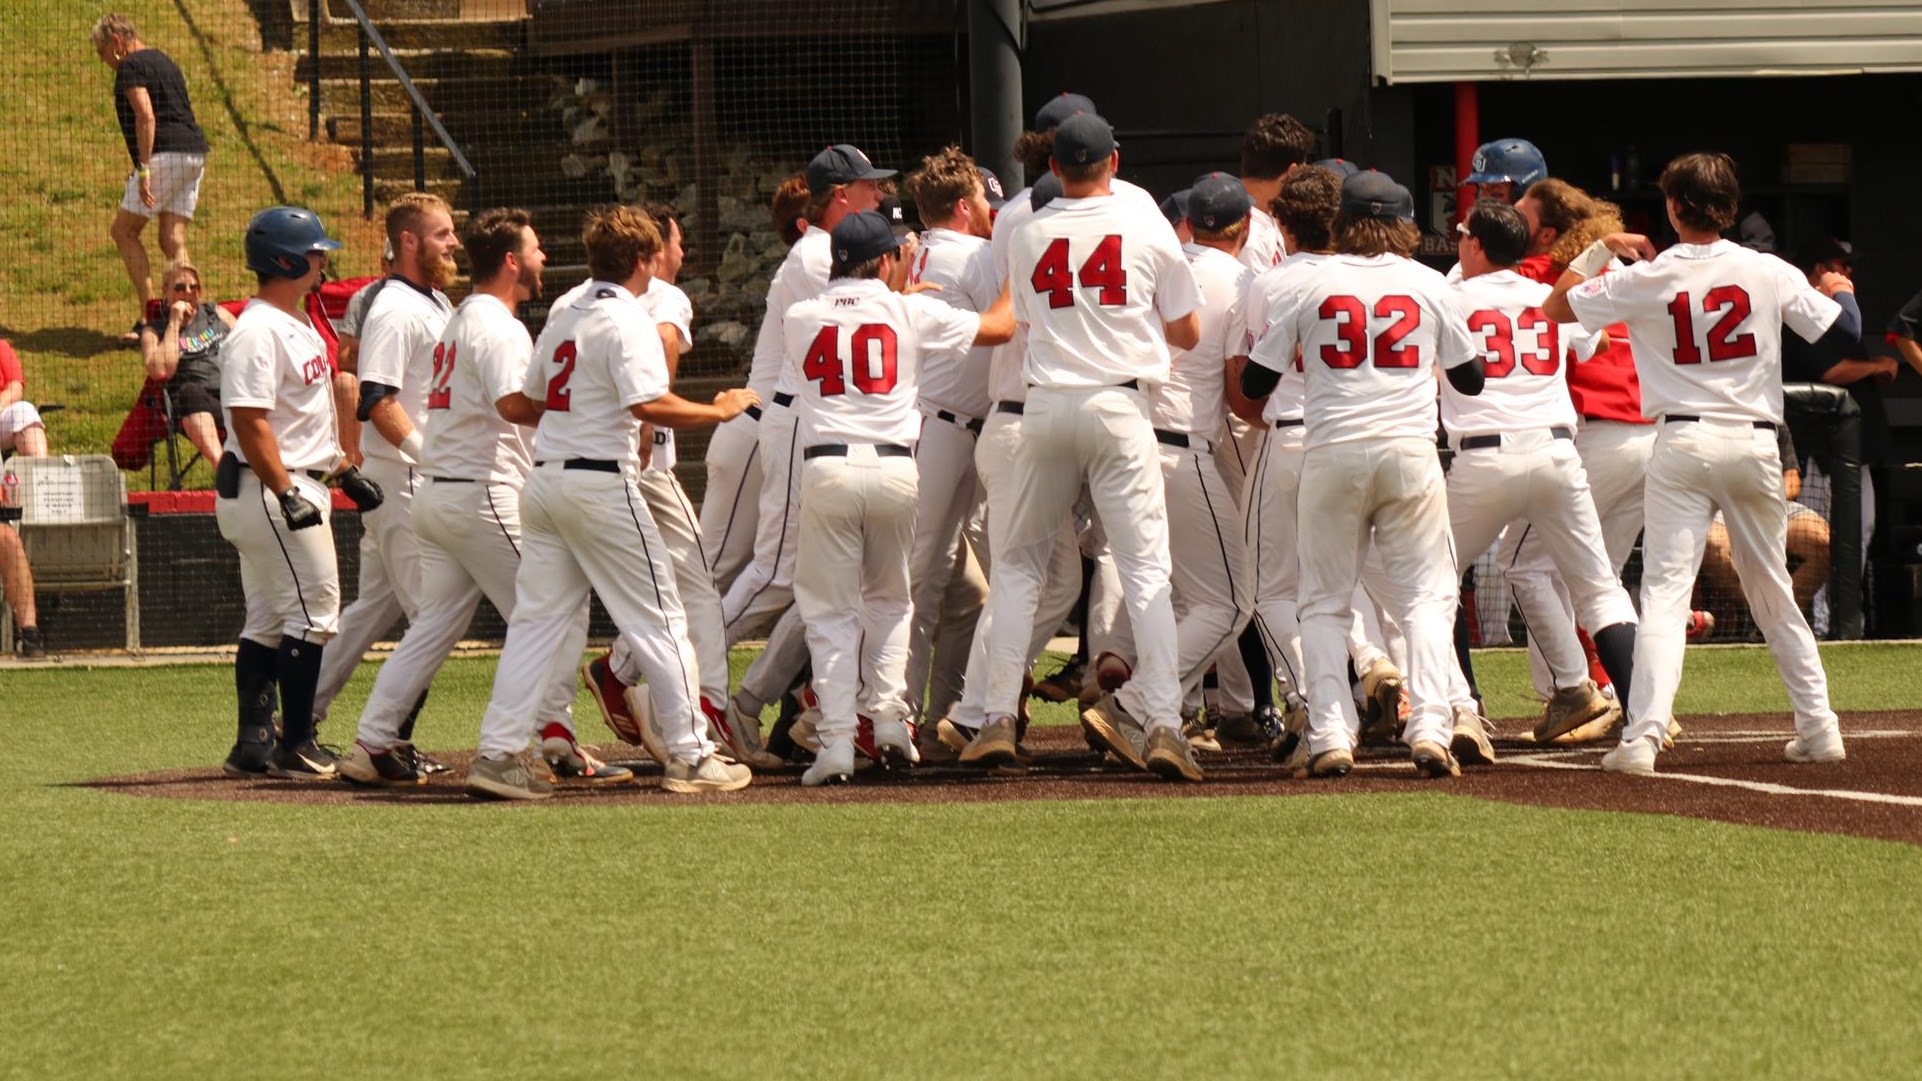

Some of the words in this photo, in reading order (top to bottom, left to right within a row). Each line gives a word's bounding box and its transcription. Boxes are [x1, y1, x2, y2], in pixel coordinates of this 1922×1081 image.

[1030, 234, 1126, 309] 44
[802, 323, 898, 397] 40
[1319, 295, 1421, 369] 32
[1467, 307, 1560, 378] 33
[1667, 284, 1757, 365] 12
[545, 339, 577, 411] 2
